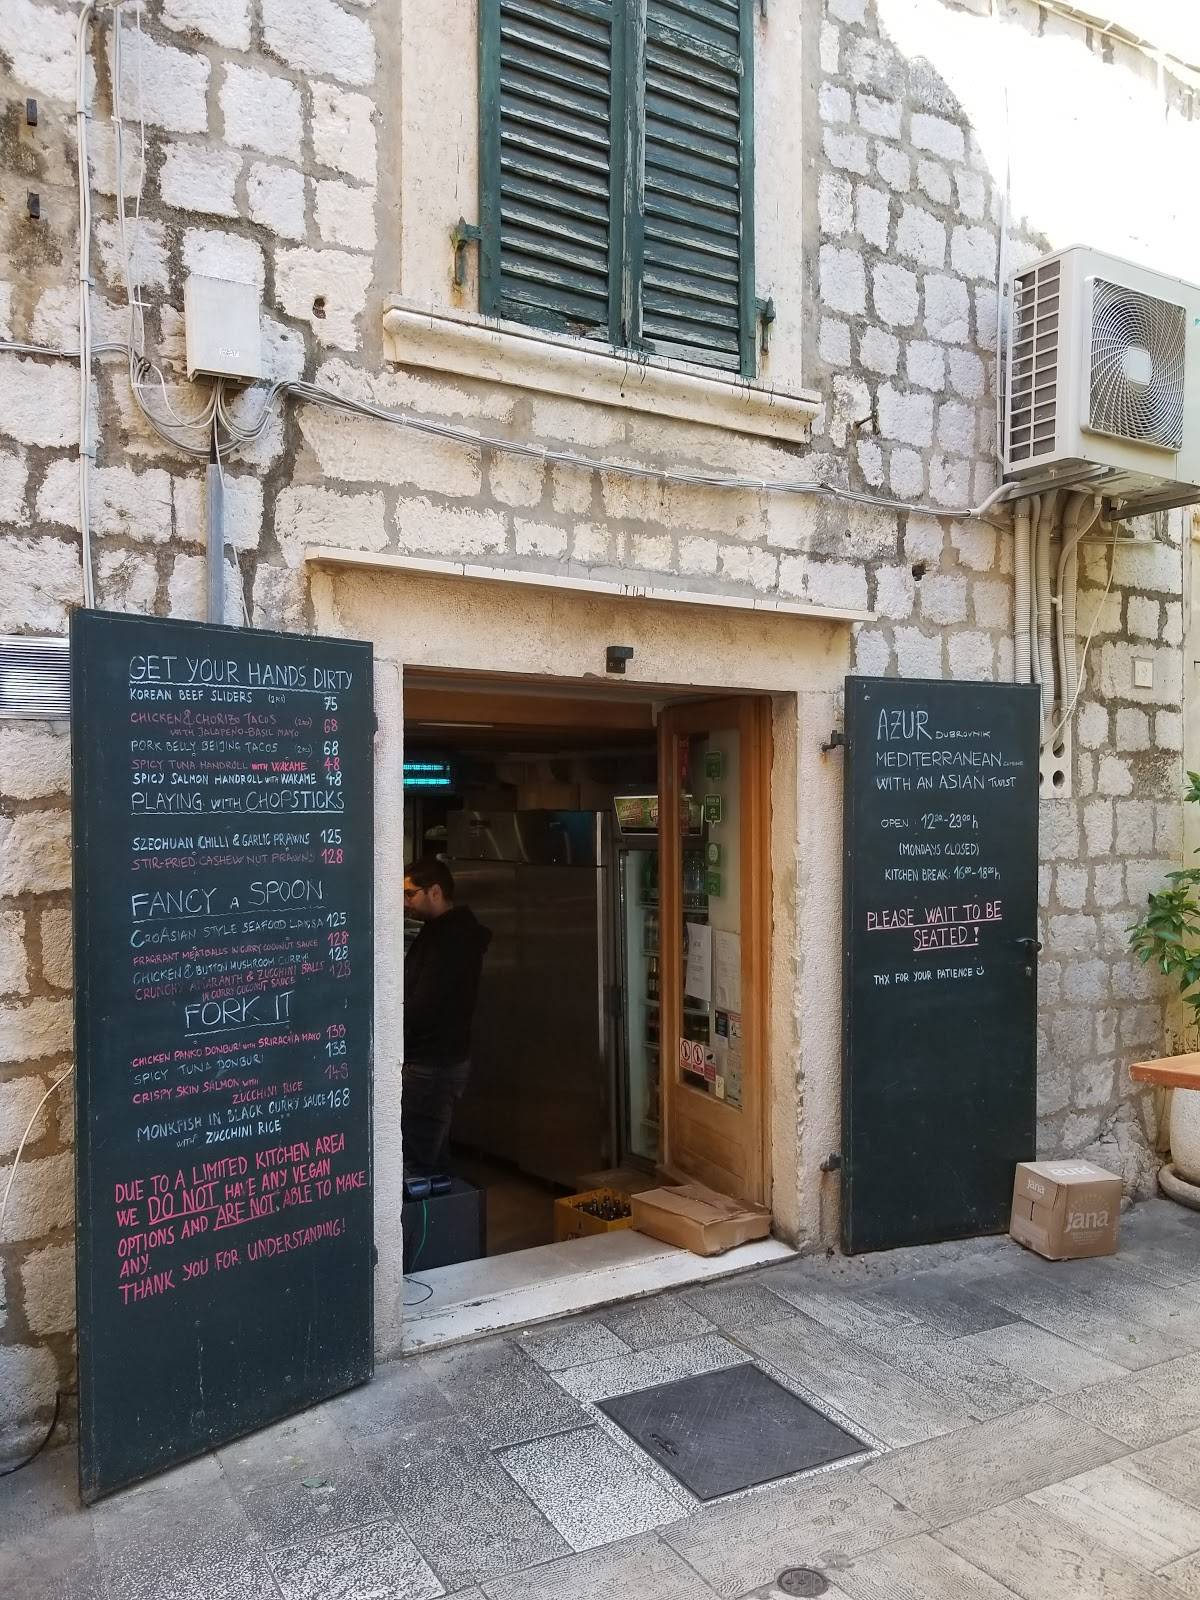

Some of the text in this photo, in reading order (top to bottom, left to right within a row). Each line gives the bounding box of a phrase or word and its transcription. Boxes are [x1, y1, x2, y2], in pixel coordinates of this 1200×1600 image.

[129, 656, 352, 690] GET YOUR HANDS DIRTY
[130, 688, 338, 711] KOREAN BEEF SLIDERS 75
[130, 712, 185, 723] CHICKEN
[244, 712, 276, 725] TACOS
[324, 719, 338, 733] 68
[170, 728, 194, 737] WITH
[877, 708, 932, 741] AZUR
[131, 740, 162, 752] PORK
[166, 741, 196, 752] BELLY
[202, 742, 240, 751] BEIJING
[245, 741, 278, 752] TACOS
[324, 741, 339, 755] 68
[876, 751, 1002, 767] MEDITERRANEAN
[131, 757, 340, 771] SPICY TUNA HANDROLL WITH WAKAME 48
[133, 771, 342, 786] SPICY SALMON HANDROLL WITH WAKAME 48
[876, 773, 1016, 791] WITH AN ASIAN TWIST
[132, 791, 344, 810] PLAYING WITH CHOPSTICKS
[132, 829, 342, 851] SZECHUAN CHILLI & GARLIC PRAWNS 125
[899, 842, 979, 856] (MONDAYS CLOSED)
[131, 849, 343, 870] STIR-FRIED CASHEW NUT PRAWNS 128
[885, 869, 919, 882] KITCHEN
[132, 880, 322, 916] FANCY A SPOON
[204, 923, 236, 938] STYLE
[241, 919, 286, 933] SEAFOOD
[327, 912, 347, 928] 125
[867, 900, 1002, 929] PLEASE WAIT TO BE
[133, 951, 179, 966] FRAGRANT
[182, 946, 229, 961] MEATBALLS
[296, 939, 319, 949] SAUCE
[328, 930, 349, 946] 128
[133, 966, 182, 985] CHICKEN
[184, 964, 194, 979] &
[195, 961, 229, 976] BUTTON
[231, 956, 275, 971] MUSHROOM
[328, 946, 349, 960] 128
[257, 964, 297, 980] ZUCCHINI
[301, 961, 325, 975] BALLS
[329, 959, 351, 979] 128
[873, 968, 972, 985] THX FOR YOUR PATIENCE
[271, 976, 296, 987] SAUCE
[185, 990, 295, 1028] FORK IT
[132, 1054, 171, 1068] CHICKEN
[174, 1048, 201, 1061] PANKO
[242, 1042, 256, 1050] WITH
[302, 1031, 321, 1041] MAYO
[327, 1024, 346, 1040] 138
[134, 1040, 347, 1085] SPICY TUNA DONBURI 138
[133, 1088, 173, 1104] CRISPY
[175, 1085, 199, 1098] SKIN
[202, 1078, 240, 1093] SALMON
[232, 1080, 304, 1104] ZUCCHINI RICE
[136, 1087, 350, 1142] MONKFISH IN BLACK CURRY SAUCE 168
[206, 1124, 252, 1144] ZUCCHINI
[258, 1119, 282, 1135] RICE
[115, 1133, 345, 1204] DUE TO A LIMITED KITCHEN AREA
[117, 1159, 331, 1227] WE DO NOT HAVE ANY VEGAN
[1027, 1179, 1045, 1194] jana
[118, 1226, 175, 1258] OPTIONS
[181, 1216, 208, 1240] AND
[216, 1202, 245, 1228] ARE
[282, 1184, 312, 1208] ABLE
[315, 1180, 332, 1200] TO
[335, 1170, 368, 1194] MAKE
[1064, 1210, 1108, 1232] jana
[118, 1217, 346, 1305] THANK YOU FOR UNDERSTANDING!
